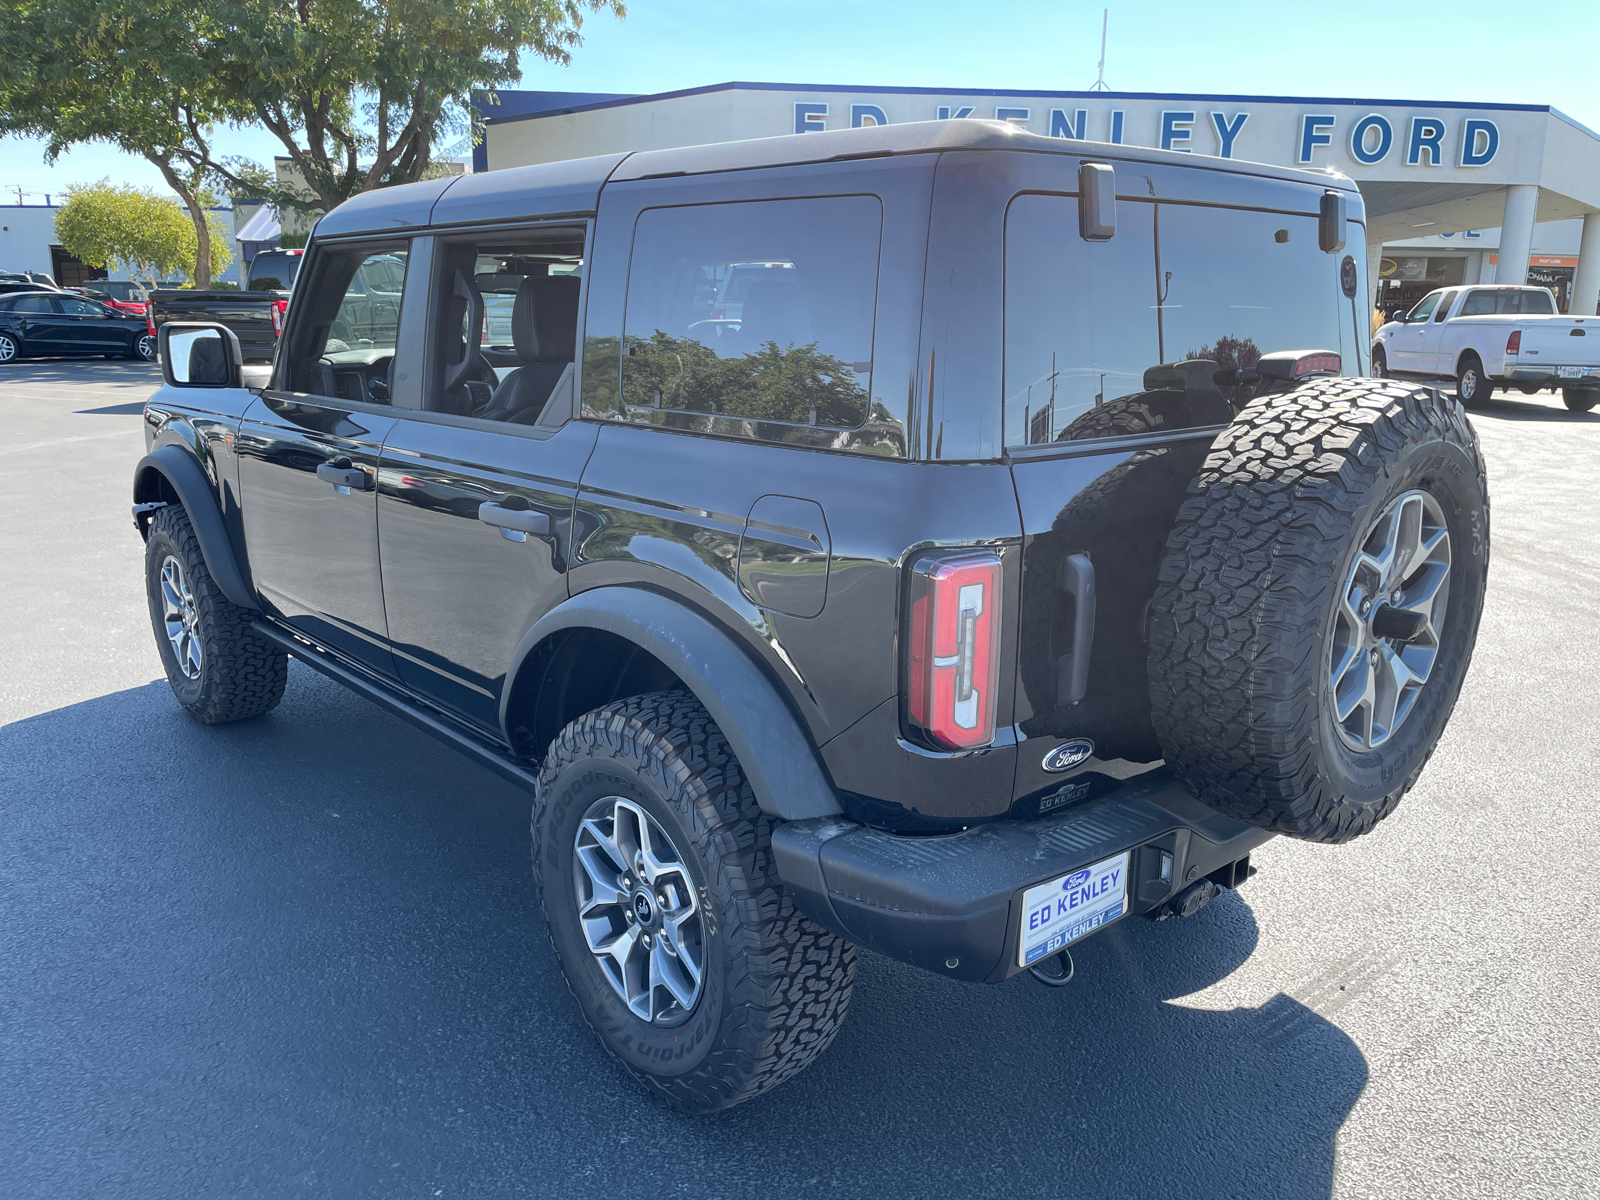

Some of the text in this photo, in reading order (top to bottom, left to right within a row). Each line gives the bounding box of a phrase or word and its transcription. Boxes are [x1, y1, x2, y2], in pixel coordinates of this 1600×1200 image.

[937, 106, 1250, 158] NLEY
[1299, 112, 1500, 167] FORD
[1055, 747, 1084, 768] Ford
[1040, 799, 1053, 810] ED
[1054, 785, 1090, 805] KENLEY
[547, 769, 645, 871] BFGoodrich
[1029, 904, 1052, 931] ED
[1057, 868, 1121, 917] KENLEY
[1066, 871, 1087, 889] Ford
[1046, 935, 1062, 953] ED
[1064, 912, 1106, 942] KENLEY
